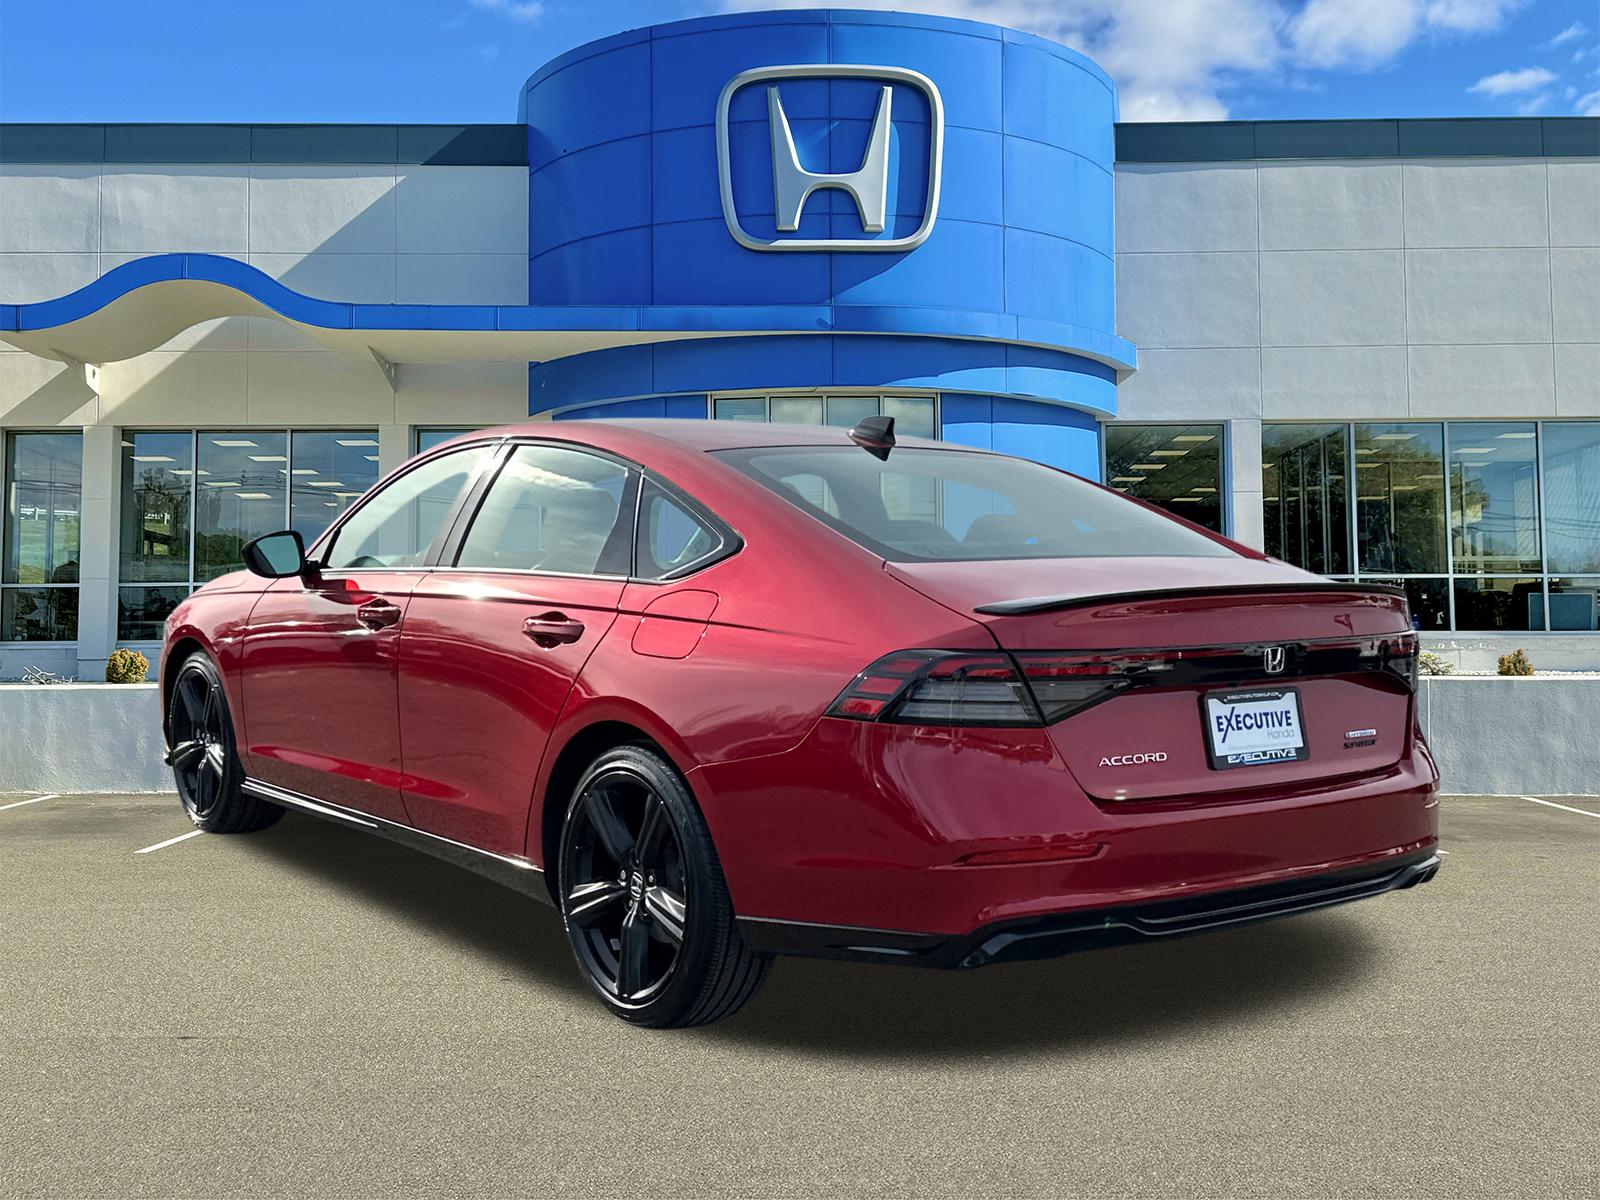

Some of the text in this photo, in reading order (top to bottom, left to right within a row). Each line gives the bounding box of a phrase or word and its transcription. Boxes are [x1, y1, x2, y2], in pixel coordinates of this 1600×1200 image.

[1216, 706, 1292, 743] EXECUTIVE
[1267, 729, 1295, 739] Honda
[1099, 752, 1167, 767] ACCORD
[1227, 748, 1296, 763] EXECUTIVE
